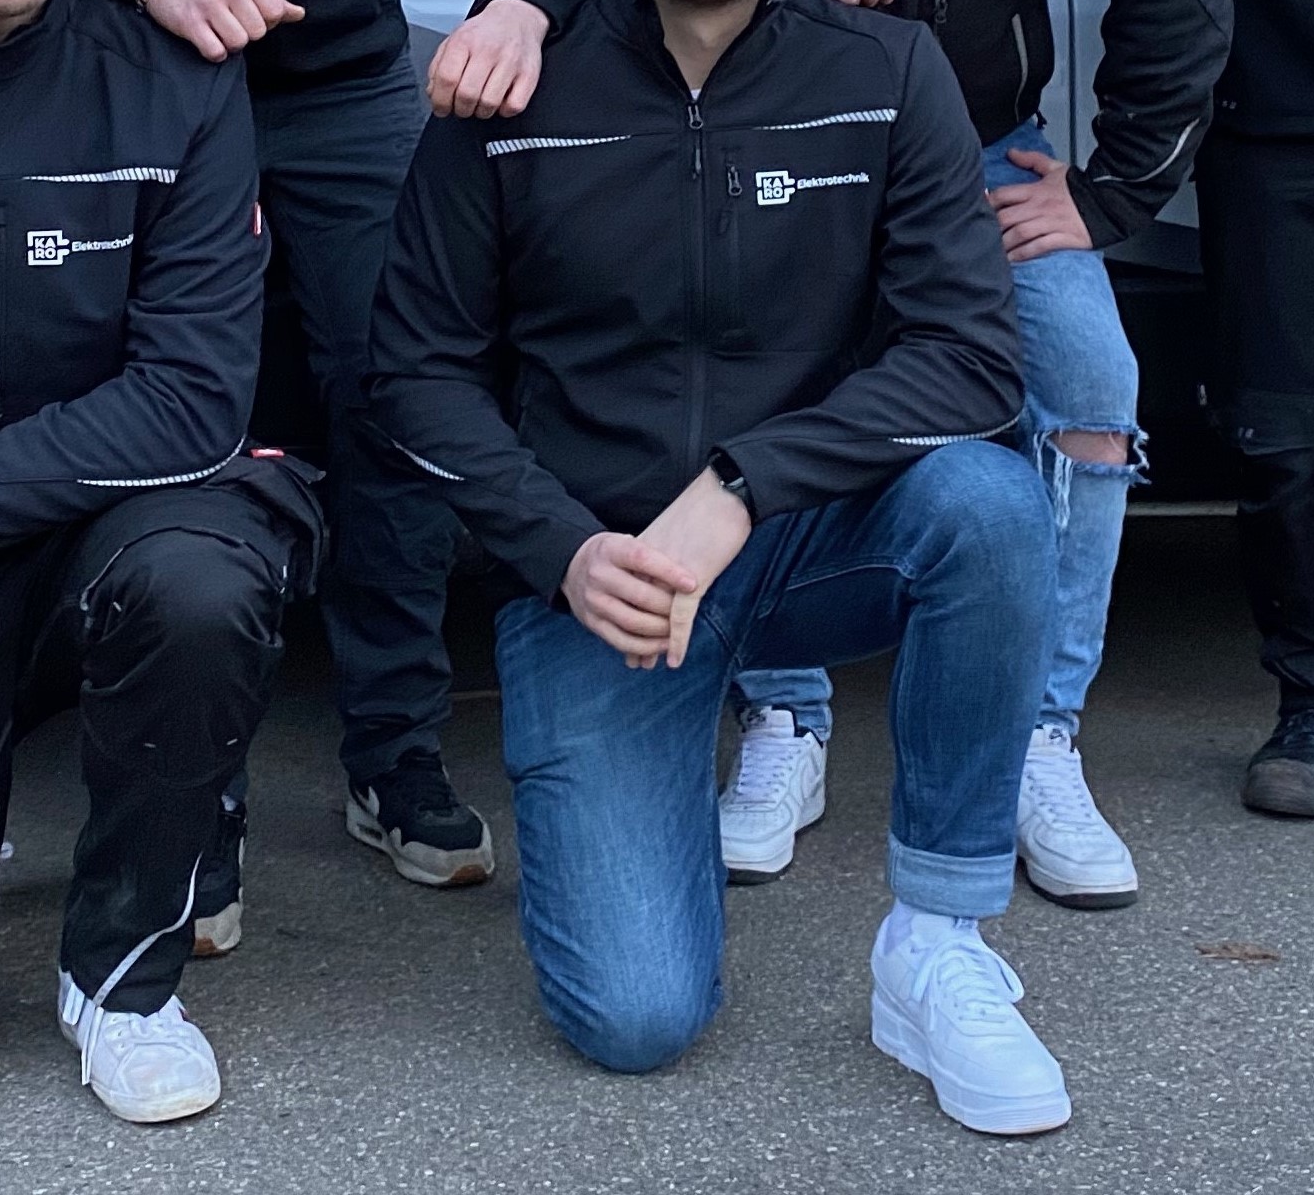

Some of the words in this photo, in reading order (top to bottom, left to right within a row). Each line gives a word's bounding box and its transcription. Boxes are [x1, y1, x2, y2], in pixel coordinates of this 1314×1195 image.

[763, 177, 783, 189] KA
[796, 171, 870, 190] Elektrotechnik
[764, 187, 784, 199] RO
[34, 237, 56, 249] KA
[35, 248, 57, 259] RO
